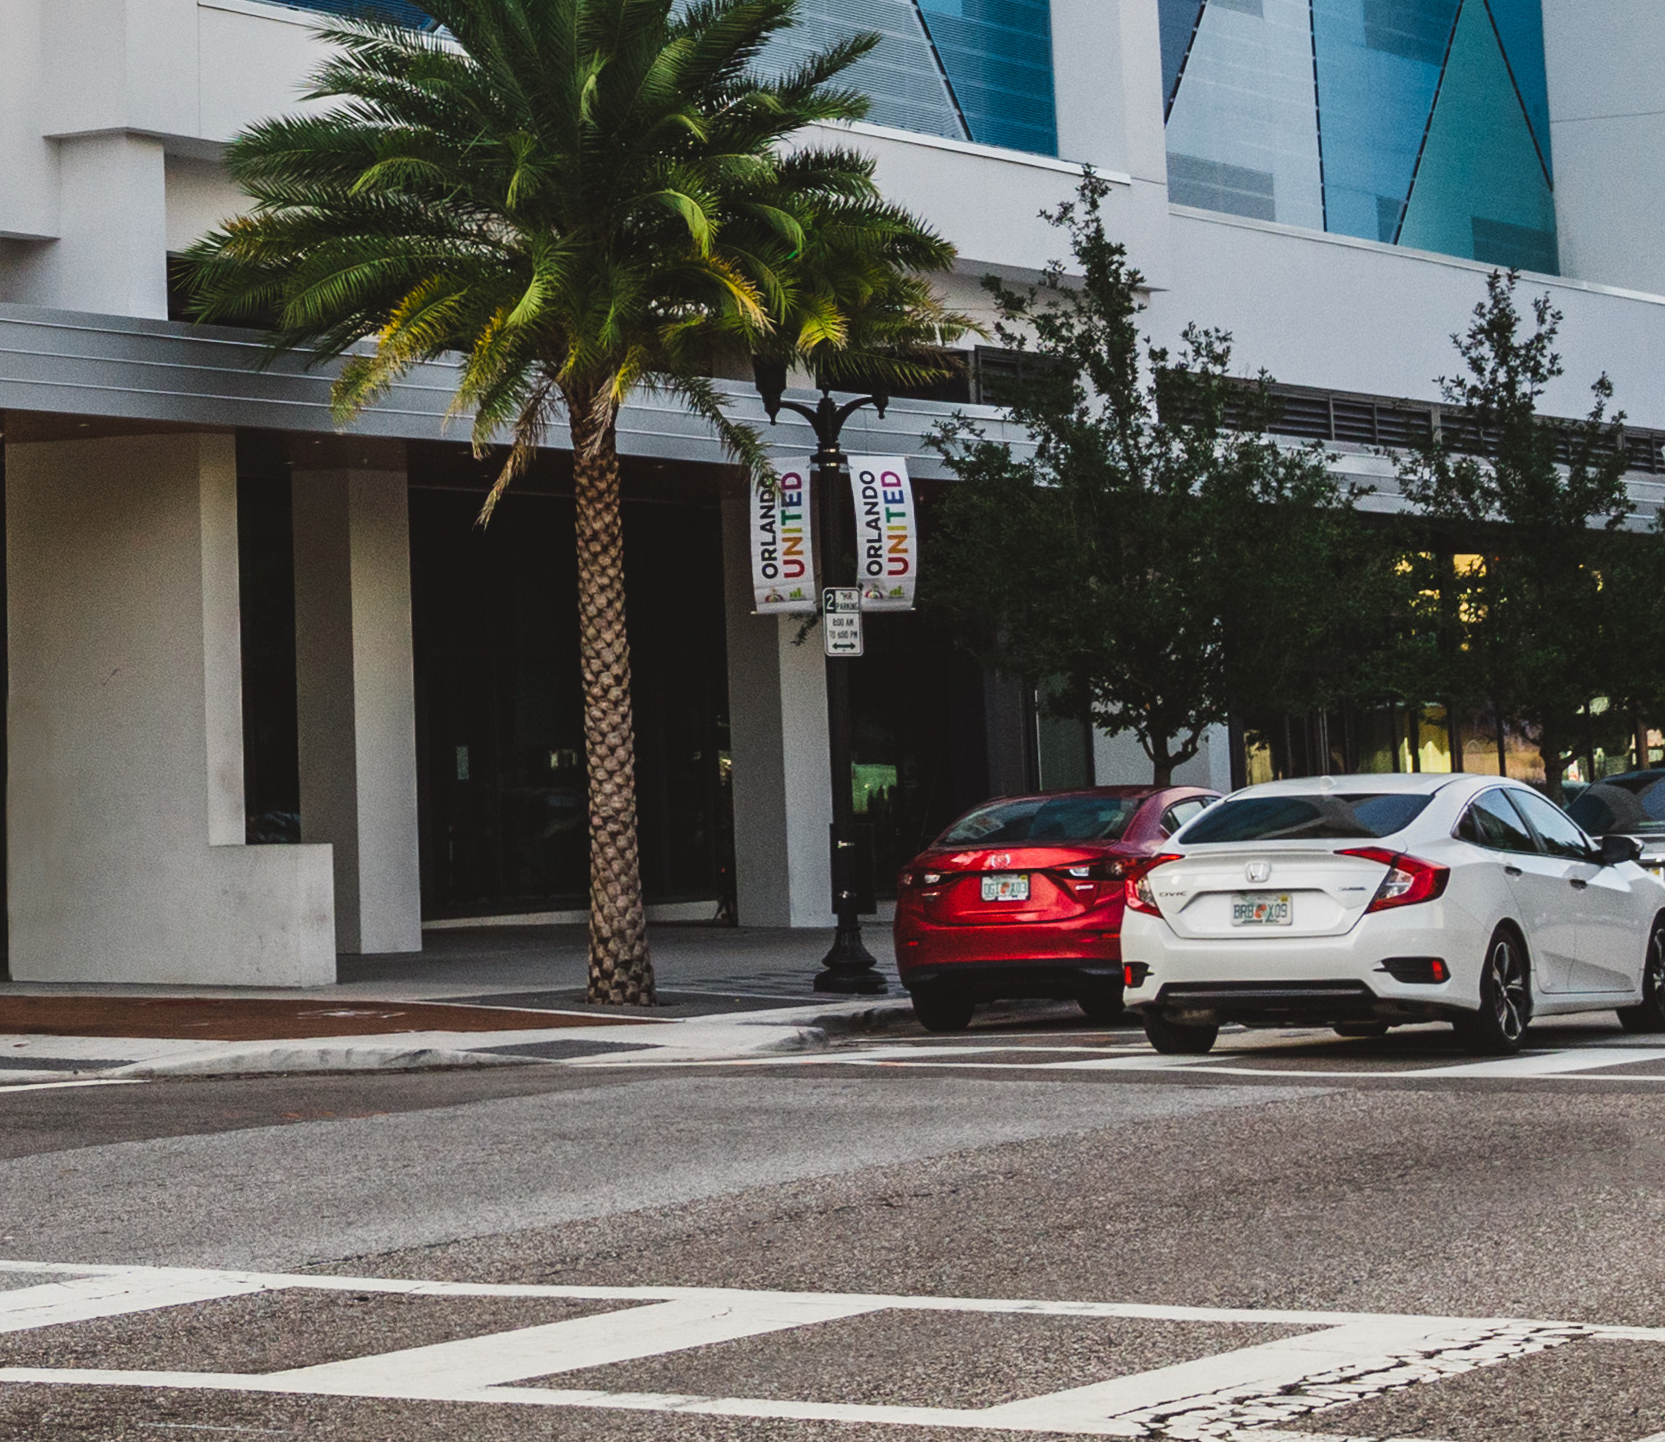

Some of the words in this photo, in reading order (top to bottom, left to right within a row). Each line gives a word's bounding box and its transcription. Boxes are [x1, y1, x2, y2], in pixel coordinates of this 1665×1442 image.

[780, 472, 806, 578] UNITED
[859, 470, 883, 576] ORLANDO
[880, 470, 909, 576] UNITED
[826, 593, 834, 609] 2
